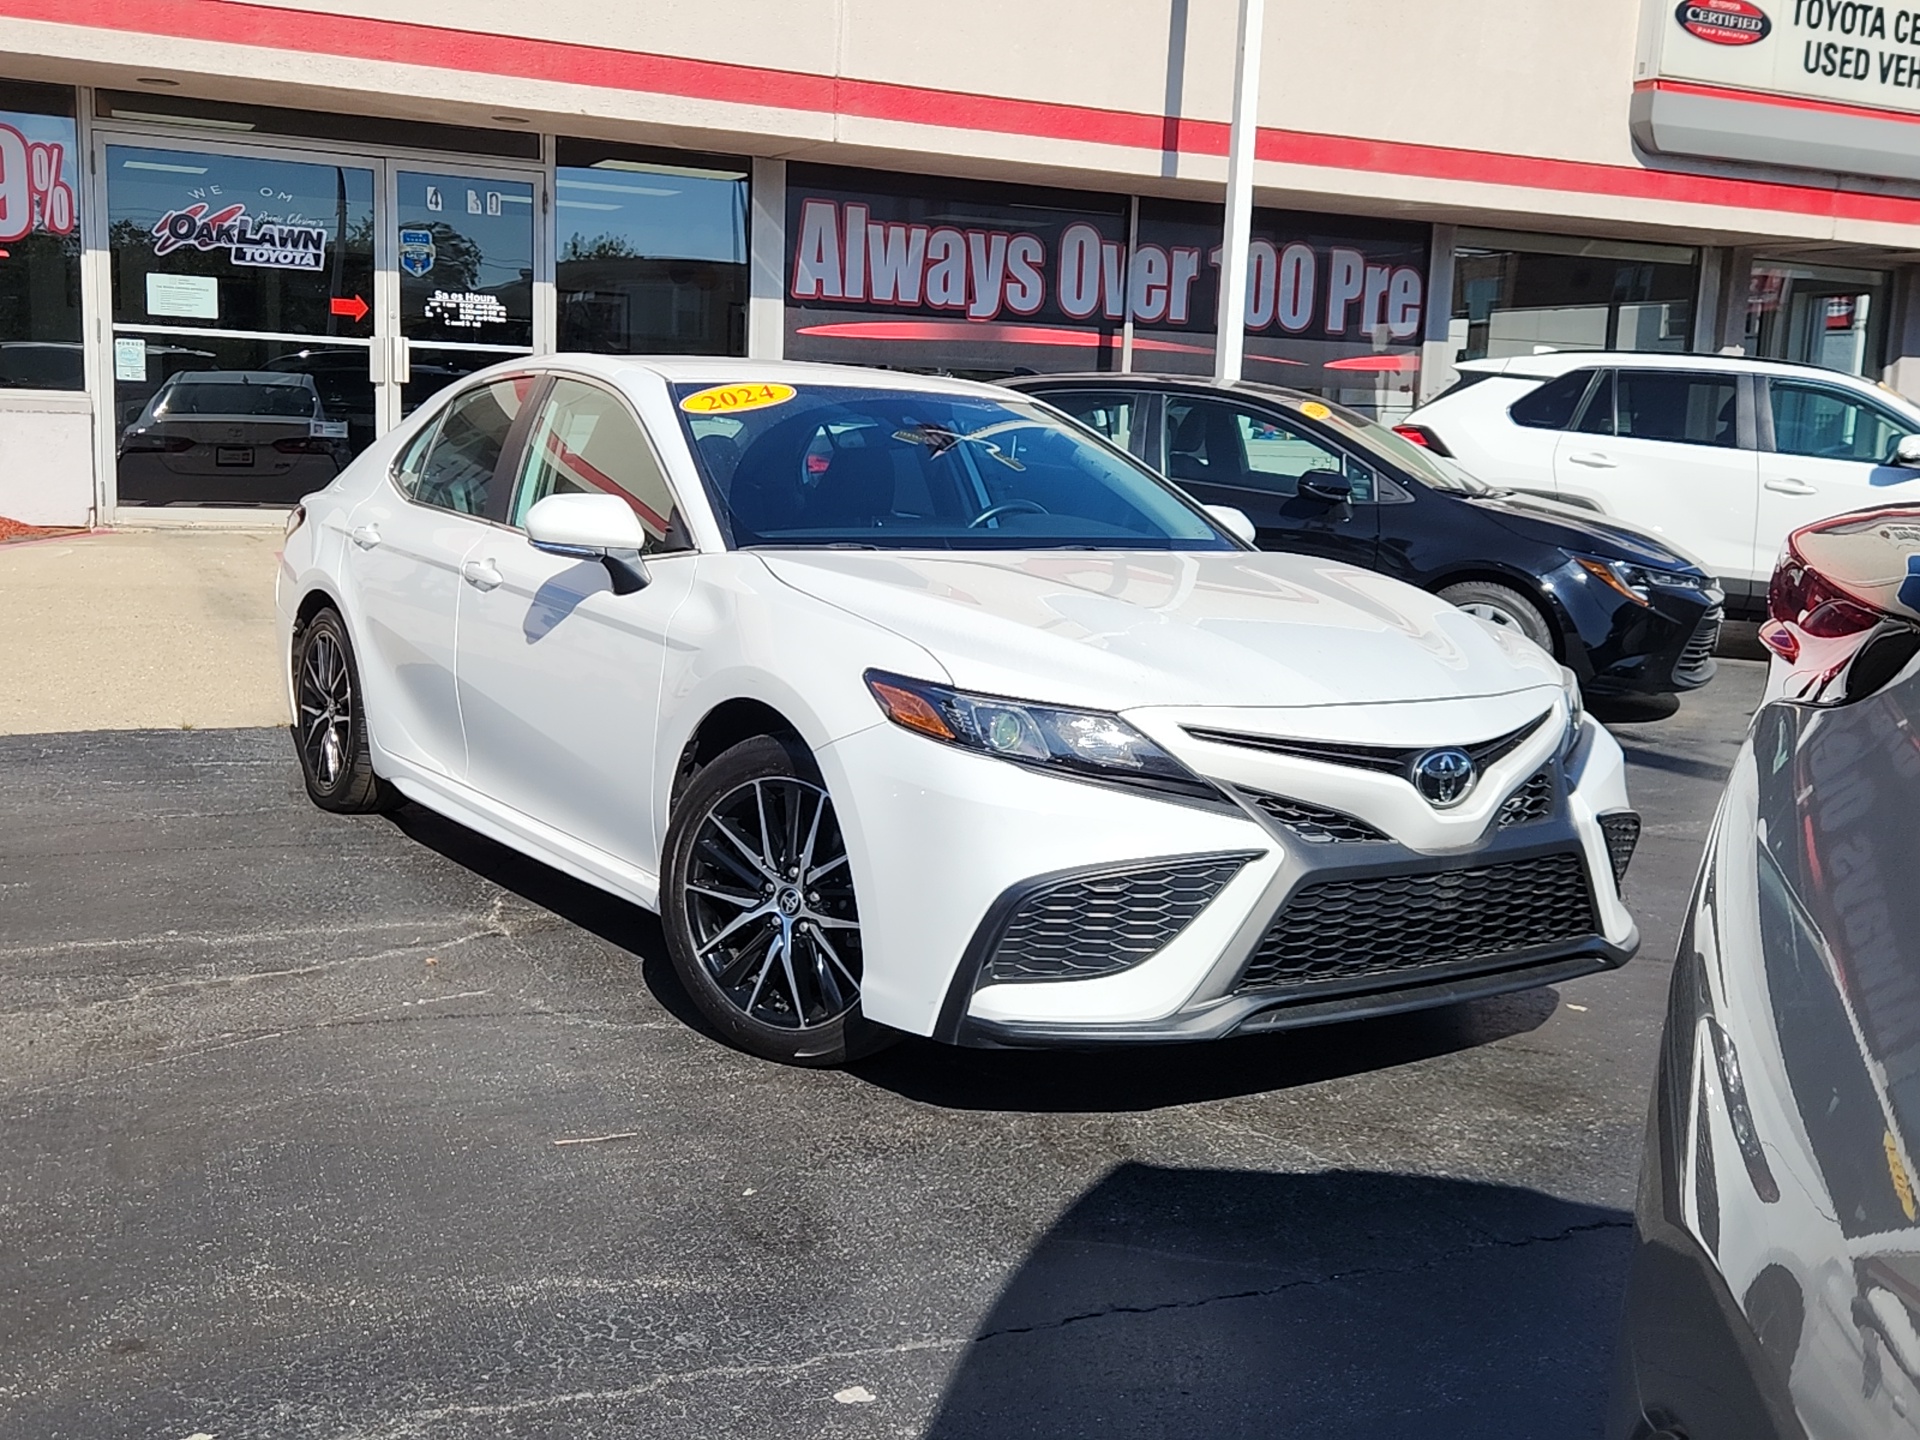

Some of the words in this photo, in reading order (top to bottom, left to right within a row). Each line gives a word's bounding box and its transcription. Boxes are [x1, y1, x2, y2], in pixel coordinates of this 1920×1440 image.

[1686, 7, 1763, 31] CERTIFIED
[1794, 0, 1885, 40] TOYOTA
[1804, 40, 1870, 81] USED
[243, 248, 315, 267] TOYOTA
[792, 198, 1046, 322] Always
[1058, 222, 1200, 323] Over
[1208, 237, 1316, 334] 00
[1325, 246, 1424, 340] Pre
[434, 290, 463, 301] Saes
[701, 385, 775, 411] 2024
